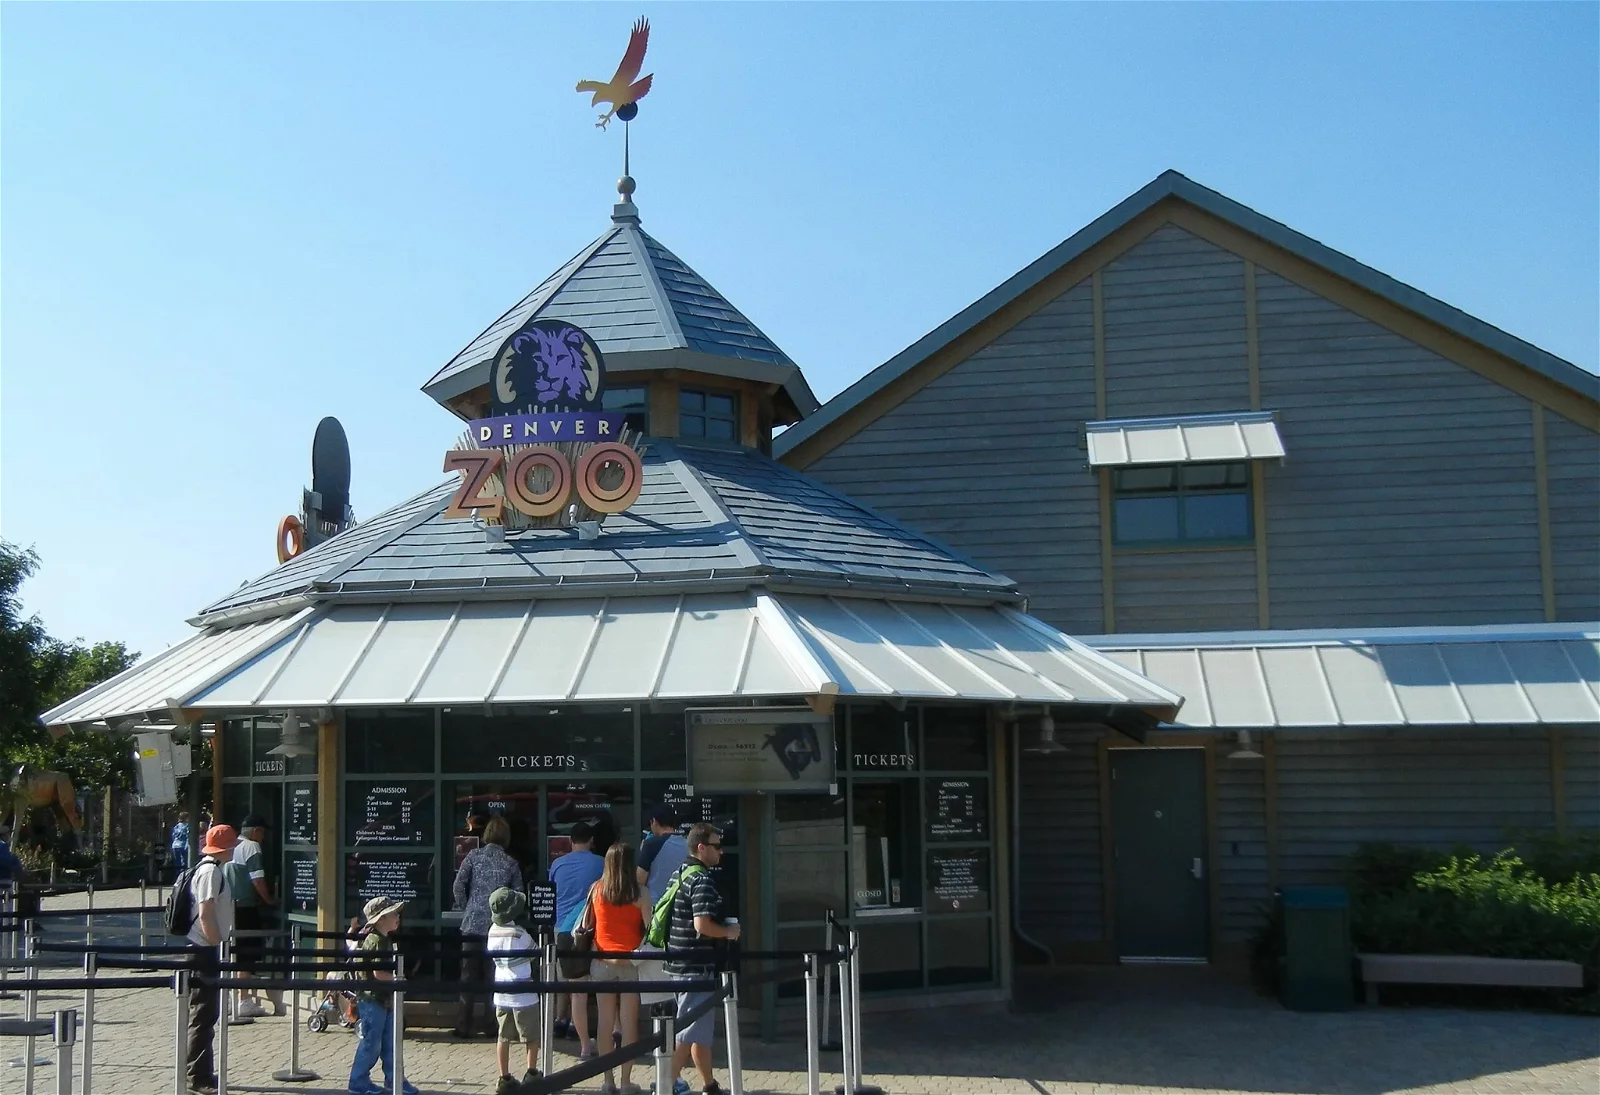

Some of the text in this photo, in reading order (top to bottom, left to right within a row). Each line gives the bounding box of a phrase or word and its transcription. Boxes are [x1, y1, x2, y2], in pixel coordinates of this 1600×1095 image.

[481, 420, 610, 441] DENVER
[443, 441, 644, 519] ZOO
[255, 760, 283, 772] TICKETS
[498, 755, 575, 768] TICKETS
[854, 754, 914, 766] TICKETS
[857, 890, 882, 898] CLOSED
